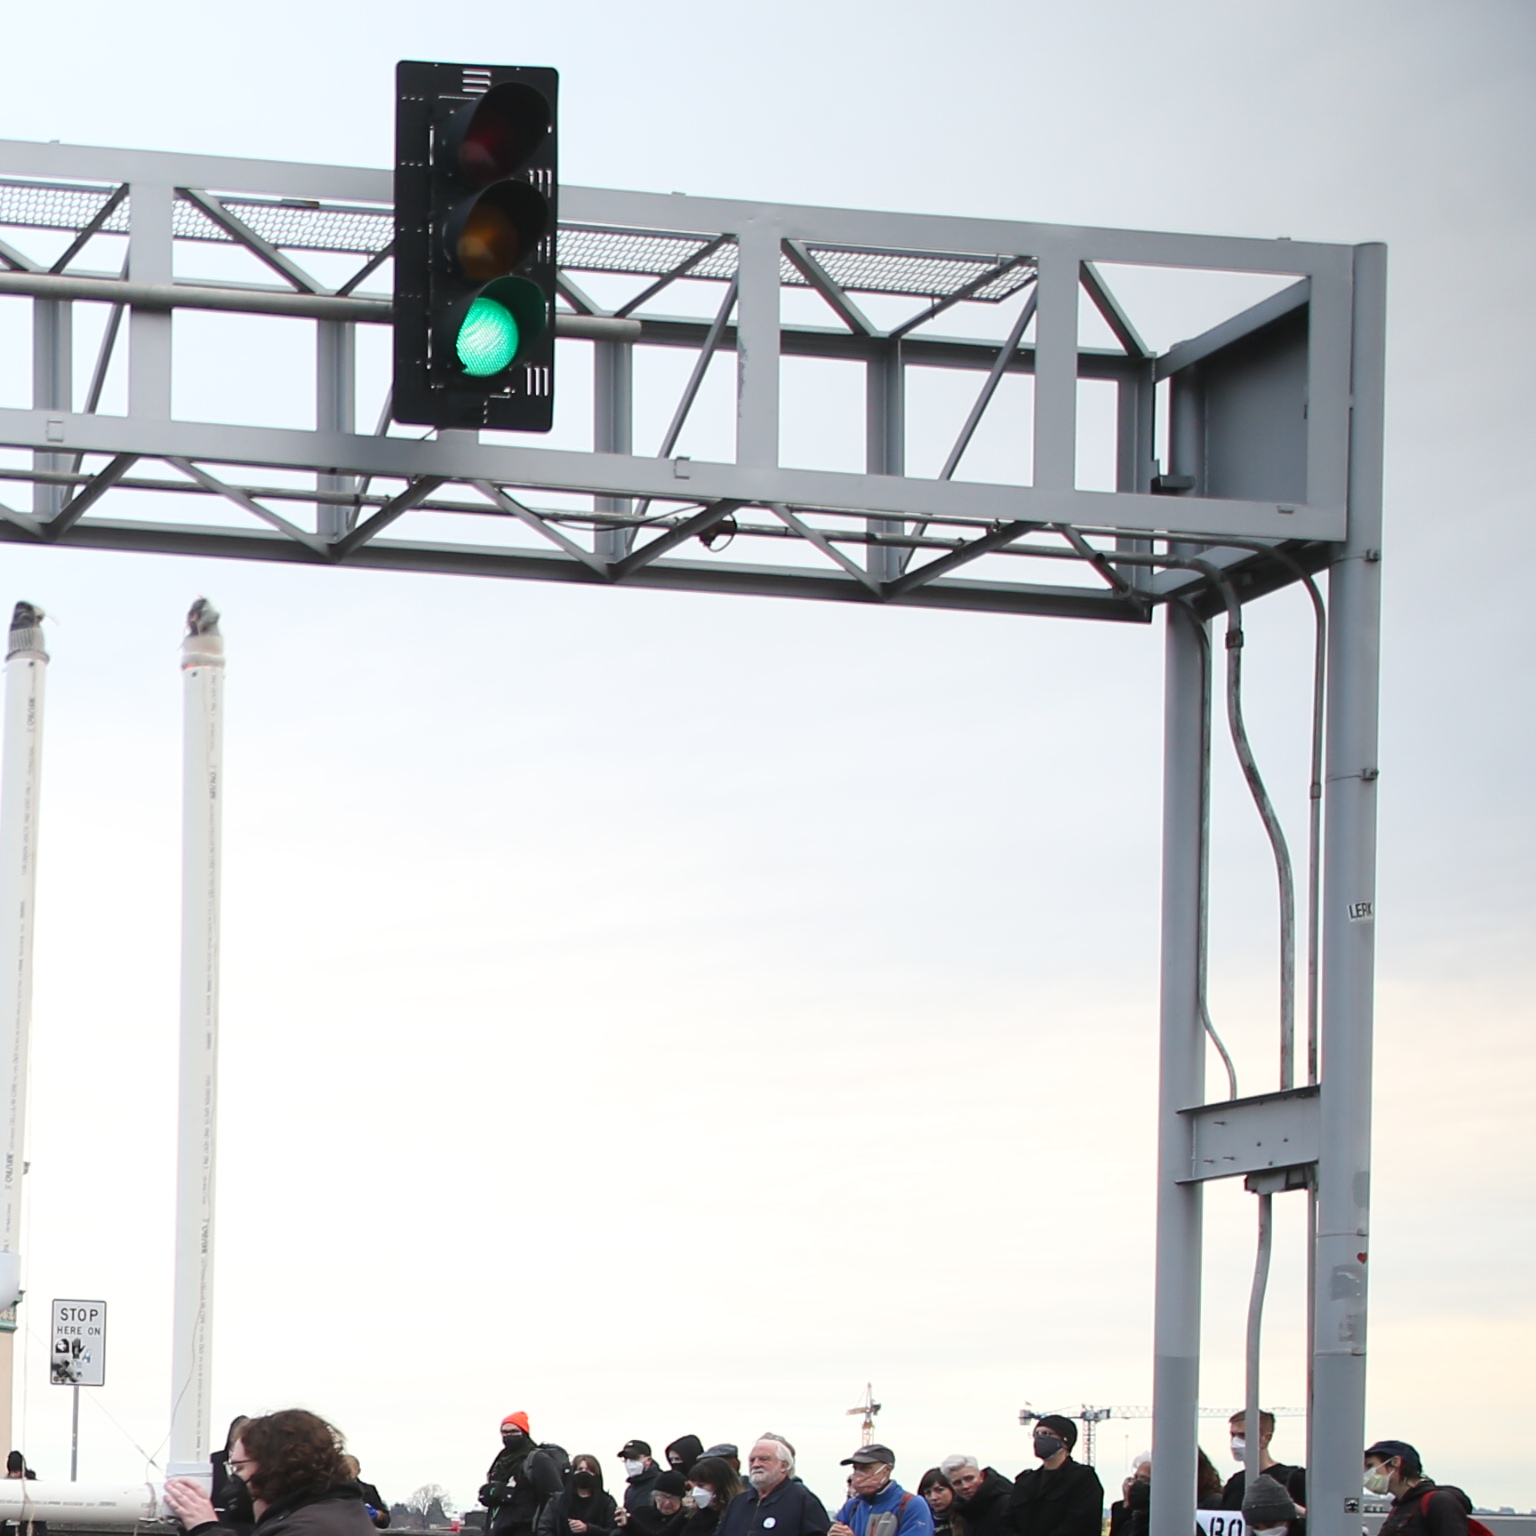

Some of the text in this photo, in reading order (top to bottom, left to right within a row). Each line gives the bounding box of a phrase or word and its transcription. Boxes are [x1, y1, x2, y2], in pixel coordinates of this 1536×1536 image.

[60, 1307, 99, 1322] STOP
[57, 1326, 101, 1336] HERE ON
